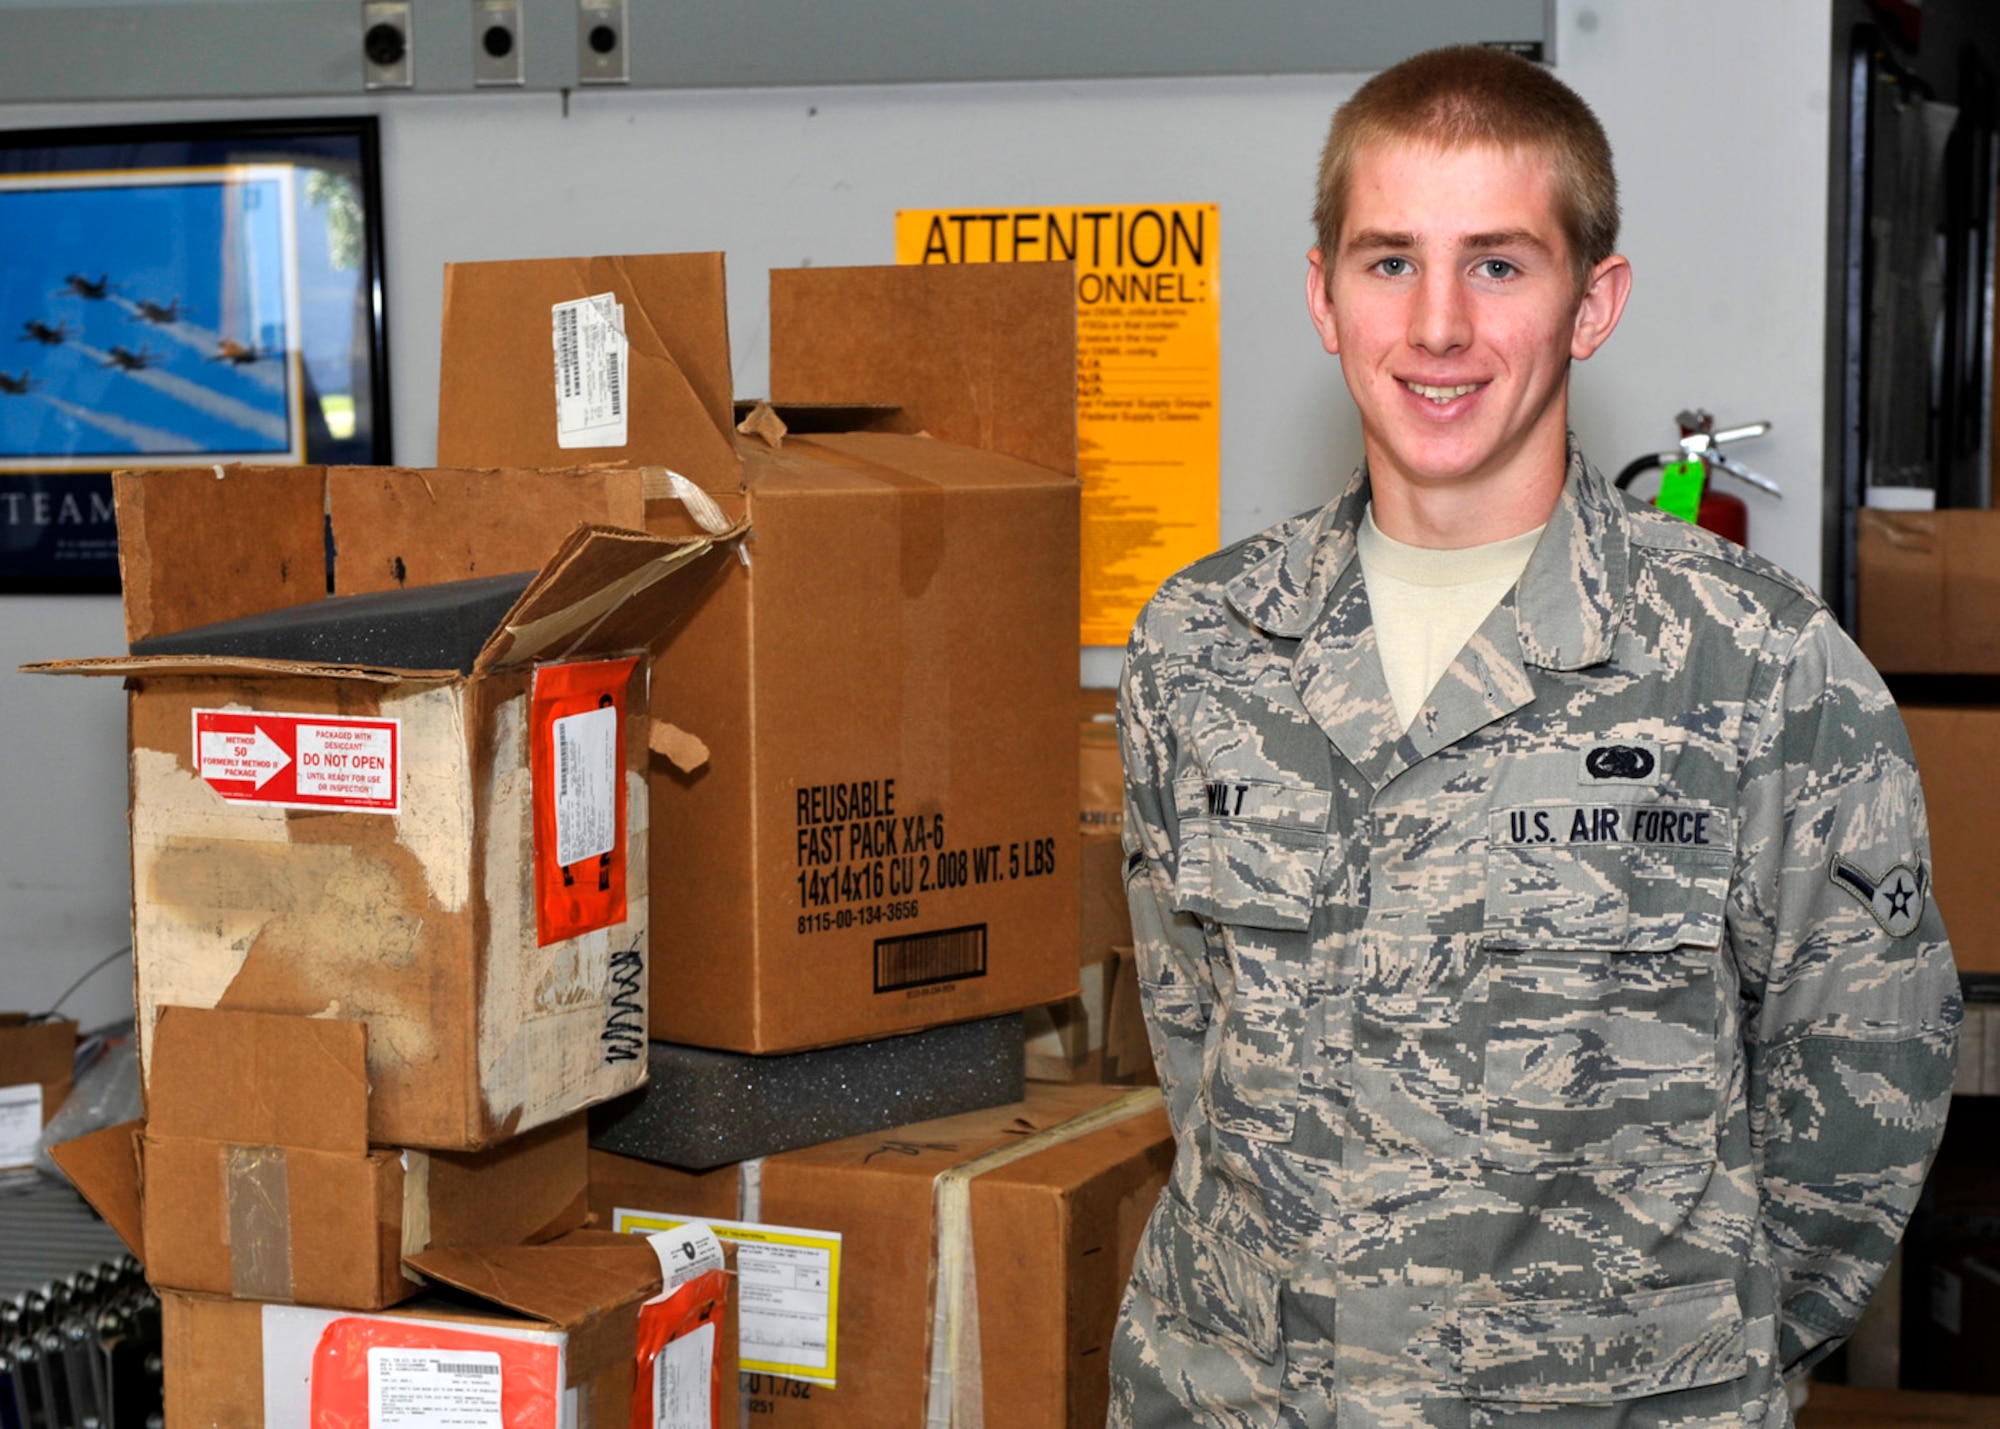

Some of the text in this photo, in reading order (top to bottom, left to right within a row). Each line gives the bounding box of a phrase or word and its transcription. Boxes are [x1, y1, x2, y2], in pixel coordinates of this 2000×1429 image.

[923, 210, 1204, 267] ATTENTION
[1078, 273, 1205, 304] ONNEL:
[1, 492, 116, 525] TEAM
[225, 736, 255, 745] METHOD
[315, 730, 372, 741] PACKAGED WITH
[234, 746, 248, 757] 50
[324, 741, 363, 751] DESICCANT
[203, 757, 240, 766] FORMERLY
[242, 759, 271, 768] METHOD
[303, 753, 385, 770] DO NOT OPEN
[224, 768, 257, 778] PACKAGE
[306, 772, 381, 784] UNTIL READY FOR USE
[318, 783, 369, 794] OR INSPECTION
[797, 778, 895, 826] REUSABLE
[1510, 808, 1711, 844] U.S. AIR FORCE
[797, 813, 943, 867] FAST PACK XA-6
[797, 837, 1055, 908] 14x14x16 CU 2.008 WT. 5 LBS
[797, 900, 919, 934] 8115-00-134-3656
